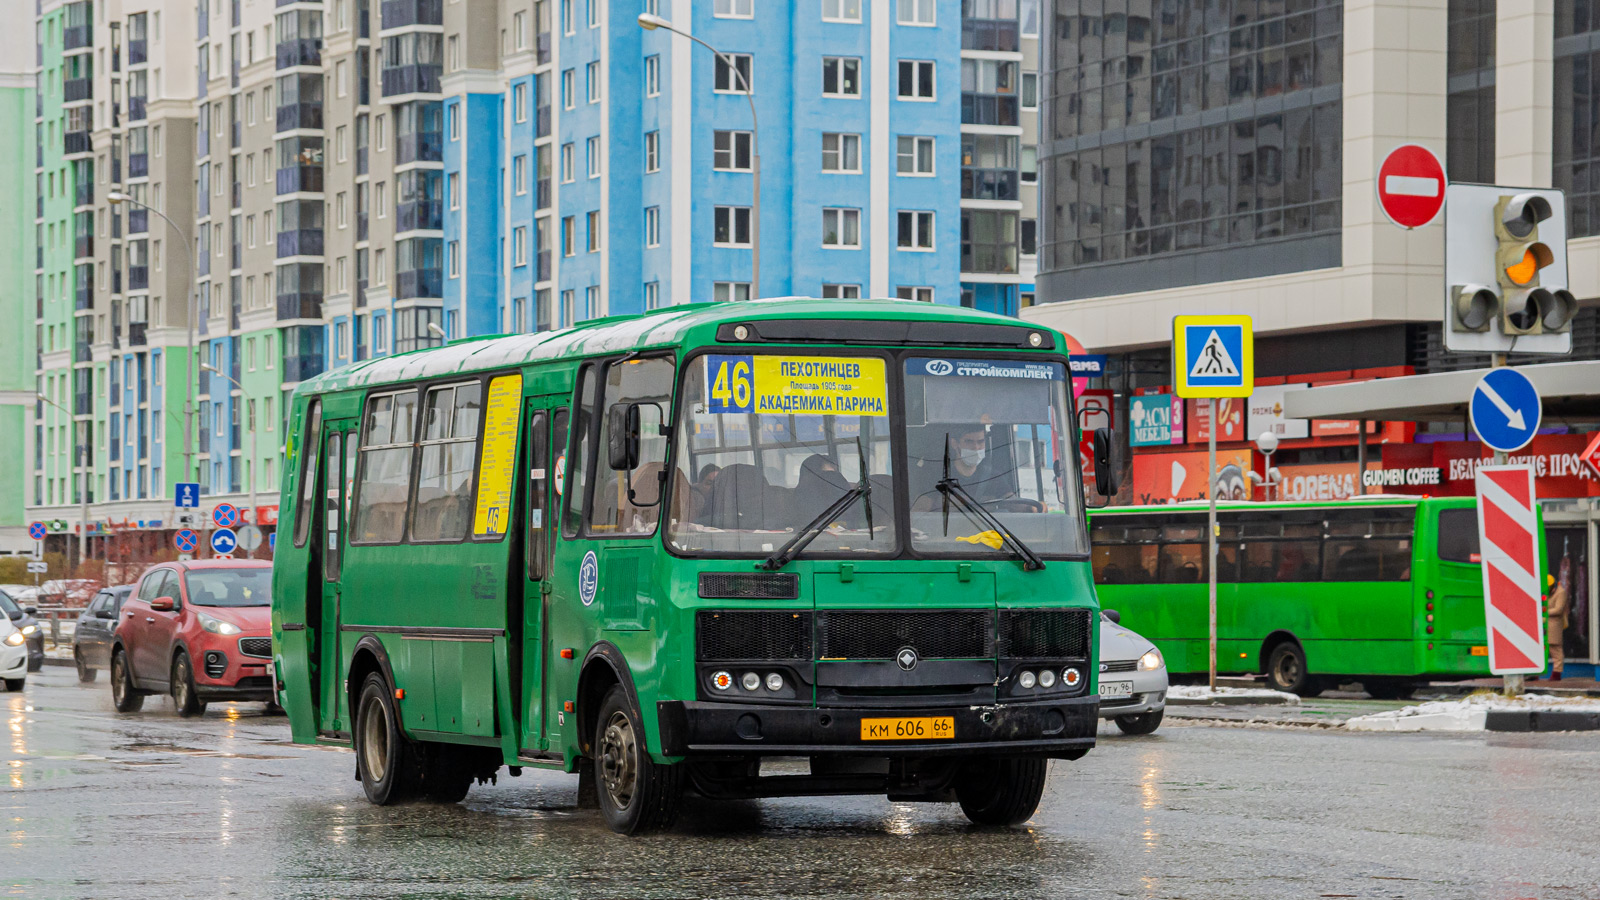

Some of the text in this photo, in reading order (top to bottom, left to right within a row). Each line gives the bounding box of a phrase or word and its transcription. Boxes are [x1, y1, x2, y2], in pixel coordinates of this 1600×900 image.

[780, 361, 861, 380] ПЕХОТИНЦЕВ
[956, 366, 1054, 379] СТРОЙКОМПЛЕКТ
[1069, 361, 1100, 371] ама
[711, 360, 751, 408] 46
[790, 381, 819, 391] Площадь
[821, 382, 836, 391] 1905
[759, 395, 883, 413] АКАДЕМИКА ПАРИНА
[1134, 426, 1171, 442] МЕБЕЛЬ
[1363, 467, 1440, 486] GUDMEN COFFEE
[1282, 473, 1355, 500] LORENA
[487, 508, 499, 532] 46
[870, 719, 948, 737] КМ 606 66
